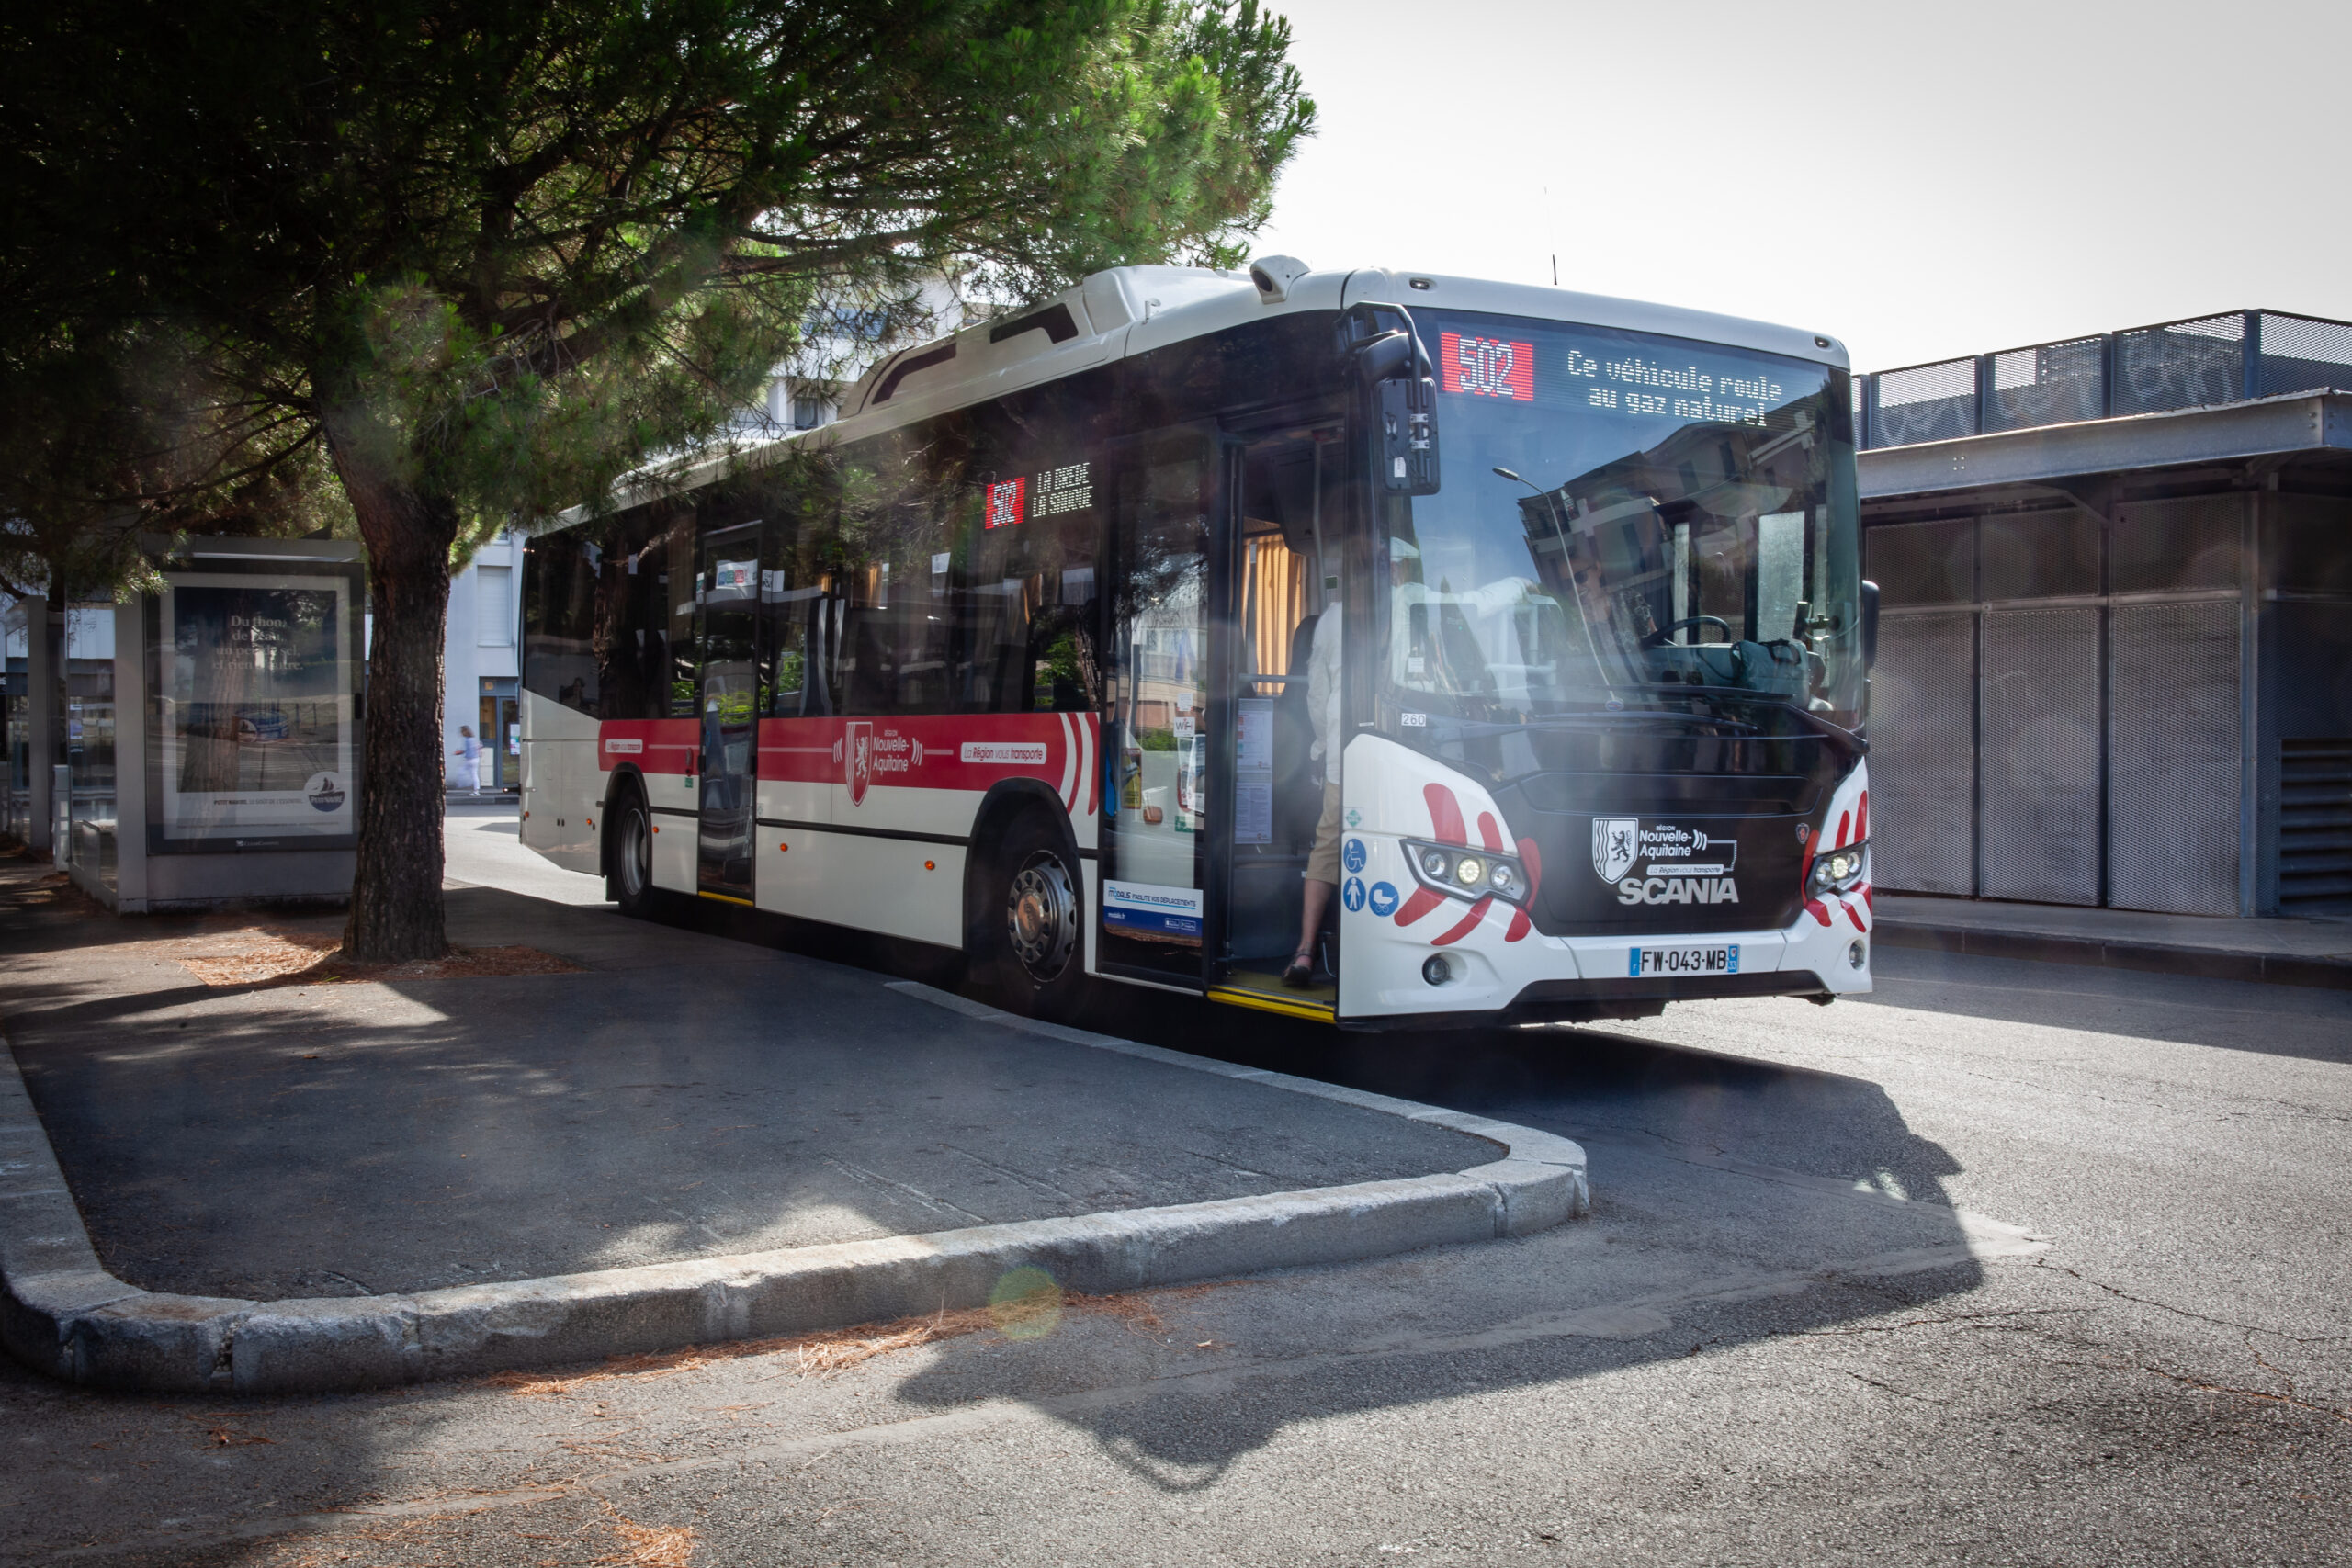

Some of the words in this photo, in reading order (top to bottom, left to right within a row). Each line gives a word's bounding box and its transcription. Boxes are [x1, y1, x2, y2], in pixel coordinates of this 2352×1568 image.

[1459, 338, 1513, 395] 502
[1567, 350, 1597, 377] Ce
[1606, 358, 1712, 392] véhicule
[1720, 376, 1782, 401] roule
[1588, 388, 1616, 408] au
[1625, 391, 1666, 414] gaz
[1674, 397, 1767, 426] naturel
[1037, 471, 1052, 493] LA
[1054, 462, 1091, 490] BREDE
[993, 482, 1017, 525] 502
[1033, 496, 1046, 517] LA
[231, 615, 250, 627] Du
[232, 629, 248, 641] de
[1403, 714, 1426, 726] 260
[873, 737, 910, 752] Nouvelle-
[965, 748, 972, 759] La
[973, 746, 994, 761] Région
[994, 750, 1010, 760] vous
[1011, 747, 1043, 762] transporte
[873, 755, 909, 775] Aquitaine
[1639, 829, 1691, 842] Nouvelle-
[1639, 843, 1691, 860] Aquitaine
[1658, 866, 1679, 874] Région
[1693, 866, 1721, 874] transporte
[1617, 877, 1739, 905] SCANIA
[1641, 950, 1727, 972] FW-043-MB
